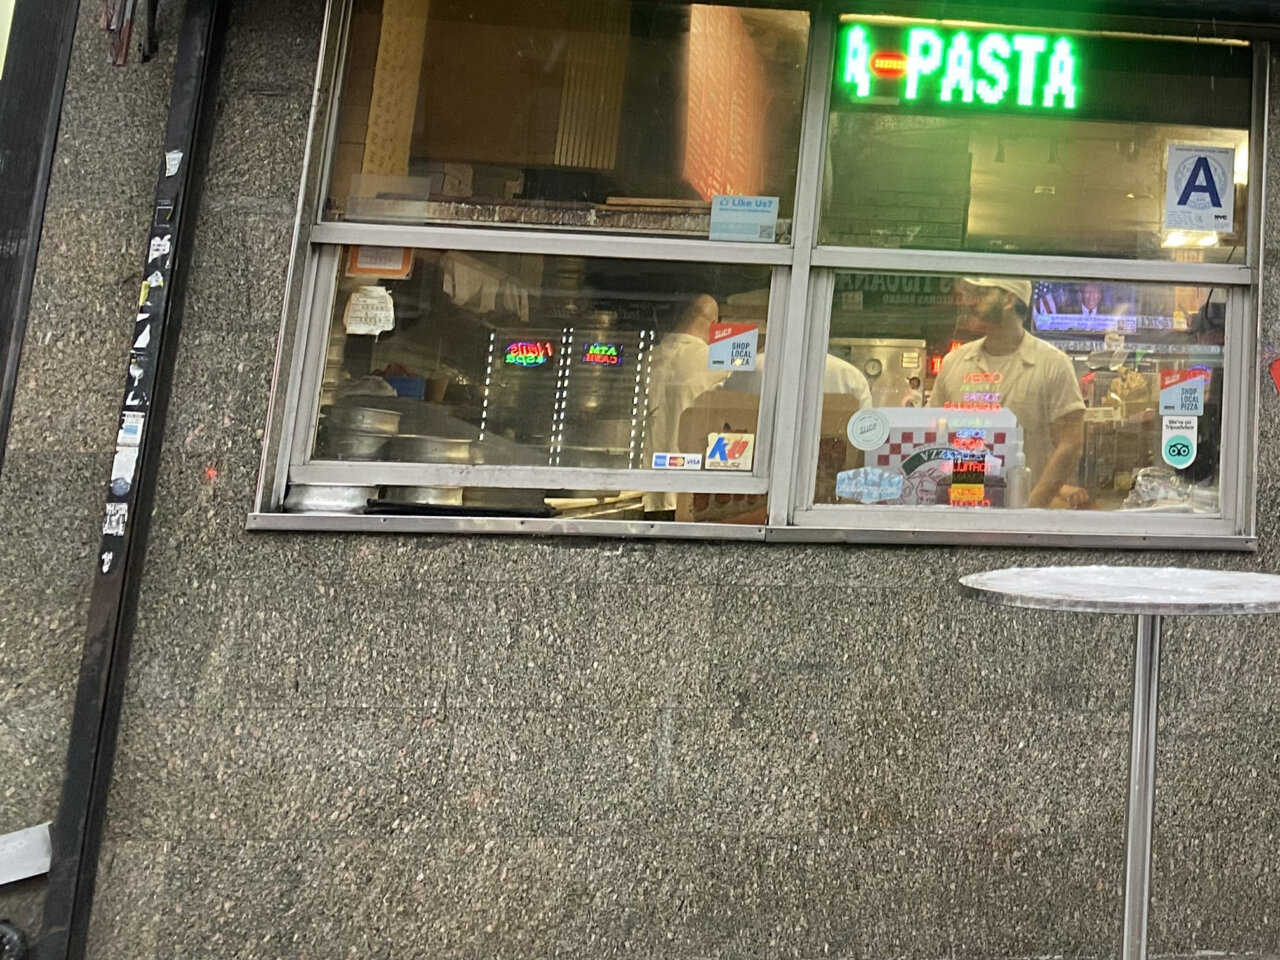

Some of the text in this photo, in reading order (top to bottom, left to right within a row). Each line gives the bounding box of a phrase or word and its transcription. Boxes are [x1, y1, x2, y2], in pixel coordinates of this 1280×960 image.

[1177, 156, 1223, 209] A
[732, 198, 774, 209] Like Us?
[731, 342, 750, 351] SHOP
[731, 350, 752, 358] LOCAL
[730, 357, 750, 366] PZA
[1181, 387, 1198, 395] SHOP
[1180, 395, 1199, 403] LOCAL
[1180, 403, 1198, 411] PIZZA
